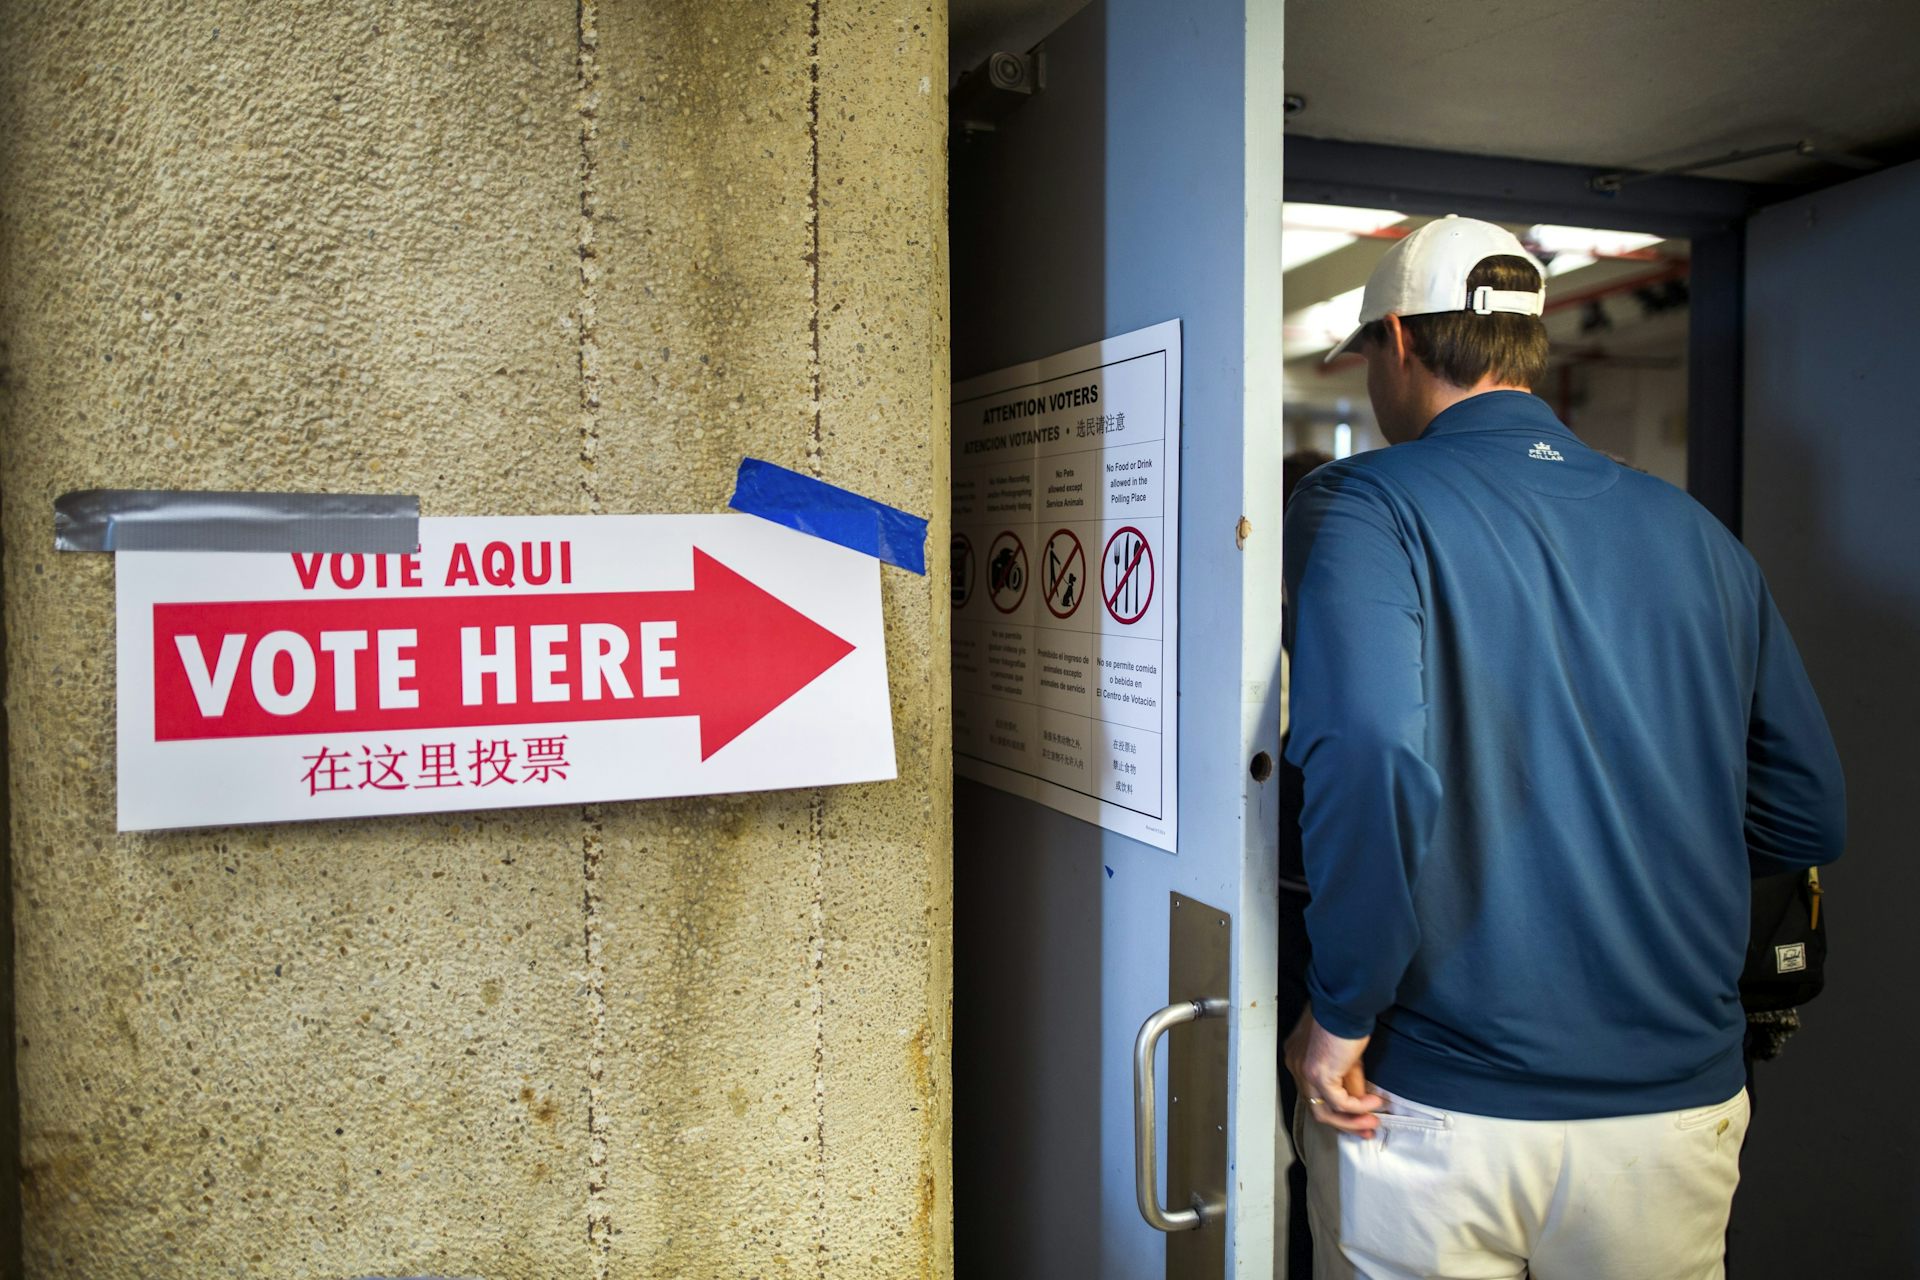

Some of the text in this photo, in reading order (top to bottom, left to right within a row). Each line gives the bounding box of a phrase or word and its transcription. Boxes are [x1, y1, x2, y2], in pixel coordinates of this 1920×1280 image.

[983, 384, 1098, 425] ATTENTION VOTERS
[1076, 412, 1126, 438] 选民请注意
[964, 426, 1060, 455] ATENCION VOTANTES
[1106, 464, 1114, 472] No
[1115, 462, 1129, 471] Food
[1137, 459, 1153, 469] Drink
[1056, 469, 1074, 478] No Pets
[1048, 483, 1082, 494] allowed except
[1110, 476, 1148, 488] allowed in the
[1046, 498, 1084, 508] Service Animals
[1111, 493, 1146, 504] Polling Place
[289, 540, 573, 590] VOTE AQUI
[1064, 652, 1082, 664] ingreso
[1082, 655, 1090, 664] de
[1097, 657, 1157, 674] No se permite comida
[173, 620, 681, 719] VOTE HERE
[1063, 668, 1082, 680] excepto
[1060, 682, 1066, 690] de
[1066, 683, 1086, 694] servicio
[1115, 676, 1134, 687] bebida
[1134, 680, 1142, 688] en
[1096, 688, 1156, 708] El Centro de Votación
[1113, 739, 1137, 754] 在投票站
[300, 734, 571, 797] 在这里投票
[1113, 760, 1137, 776] 禁止食物
[1115, 780, 1134, 795] 或饮料
